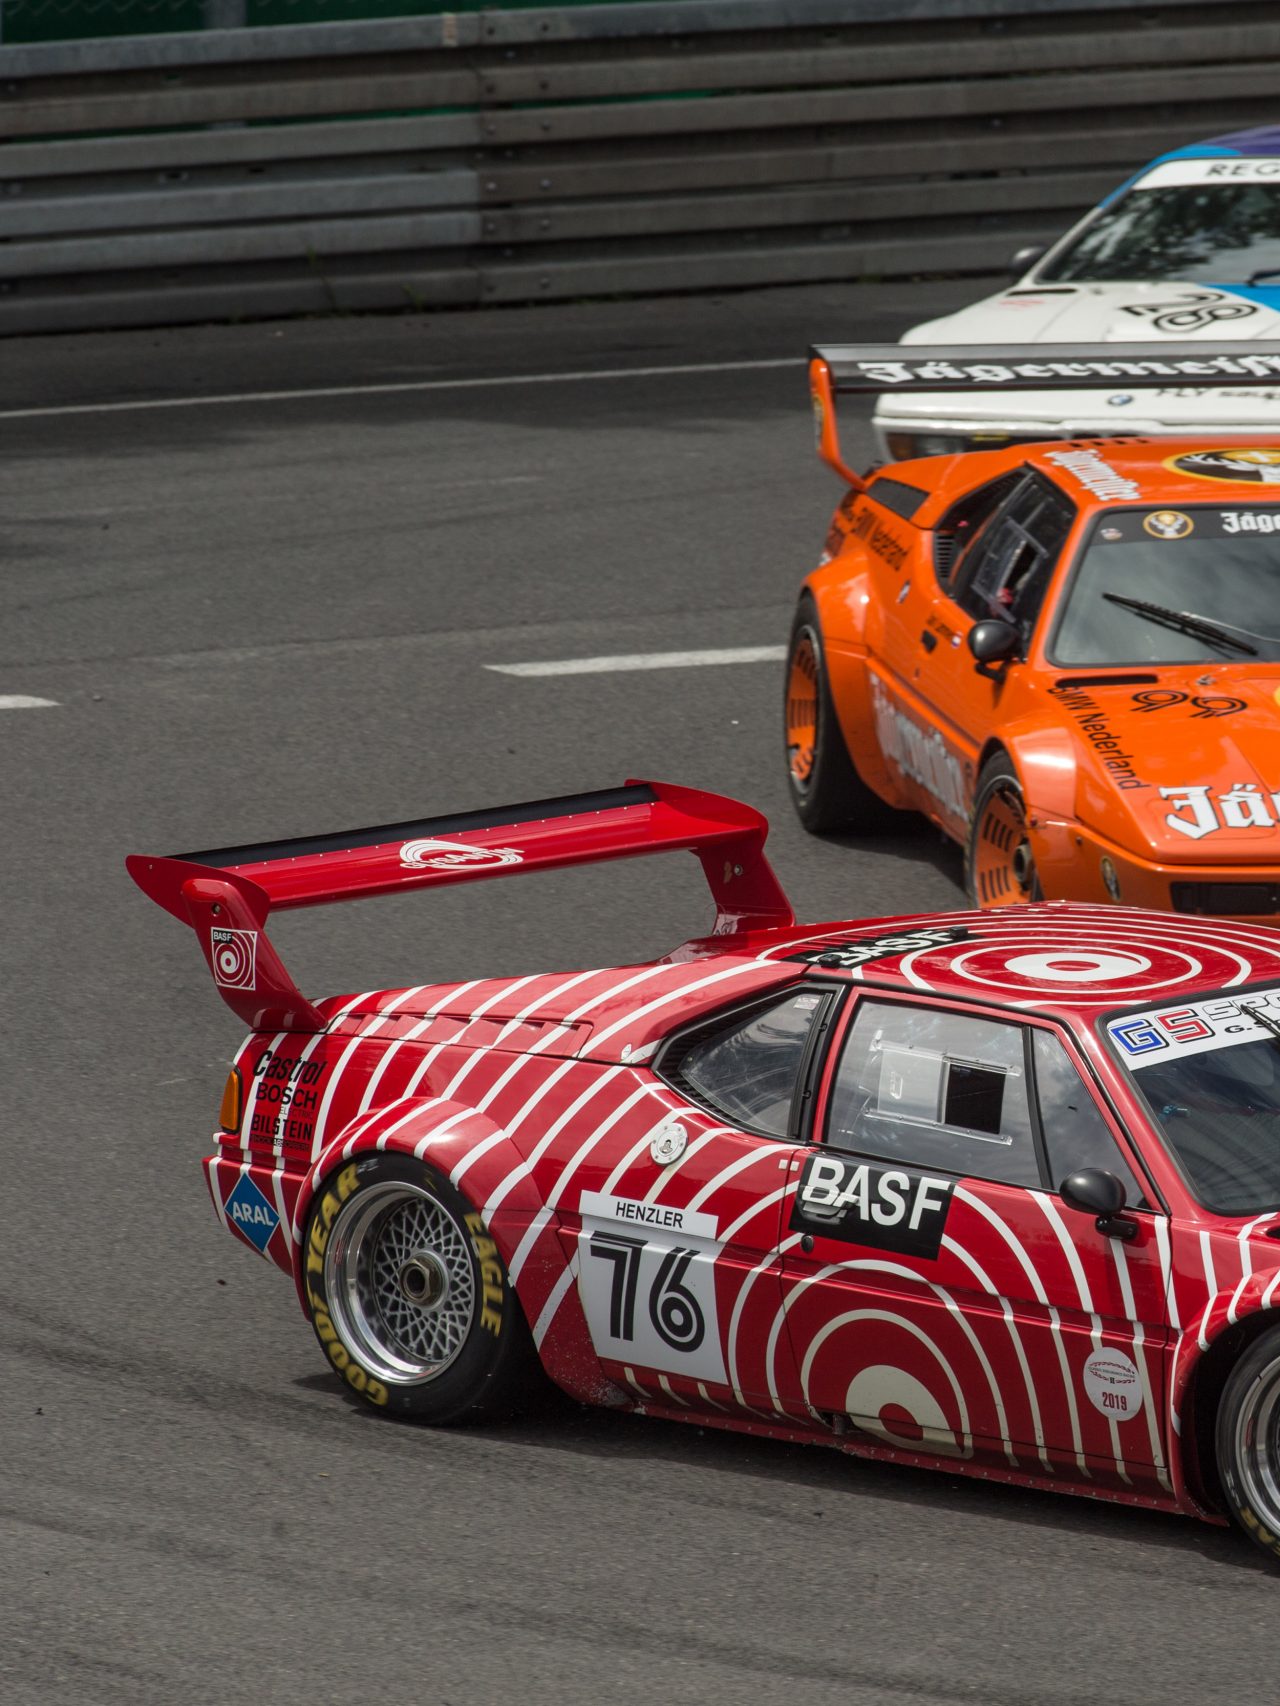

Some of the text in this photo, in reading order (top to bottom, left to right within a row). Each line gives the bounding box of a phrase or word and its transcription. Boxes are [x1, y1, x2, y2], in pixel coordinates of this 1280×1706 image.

[1119, 292, 1260, 333] 28
[1073, 712, 1152, 790] Nederland
[213, 931, 232, 942] BASF
[253, 1050, 327, 1086] Castrol
[256, 1081, 318, 1110] BOSCH
[251, 1114, 314, 1141] BILSTEIN
[801, 1156, 952, 1231] BASF
[231, 1201, 275, 1228] ARAL
[615, 1200, 684, 1230] HENZLER
[589, 1229, 706, 1354] 76
[1102, 1391, 1128, 1412] 2019
